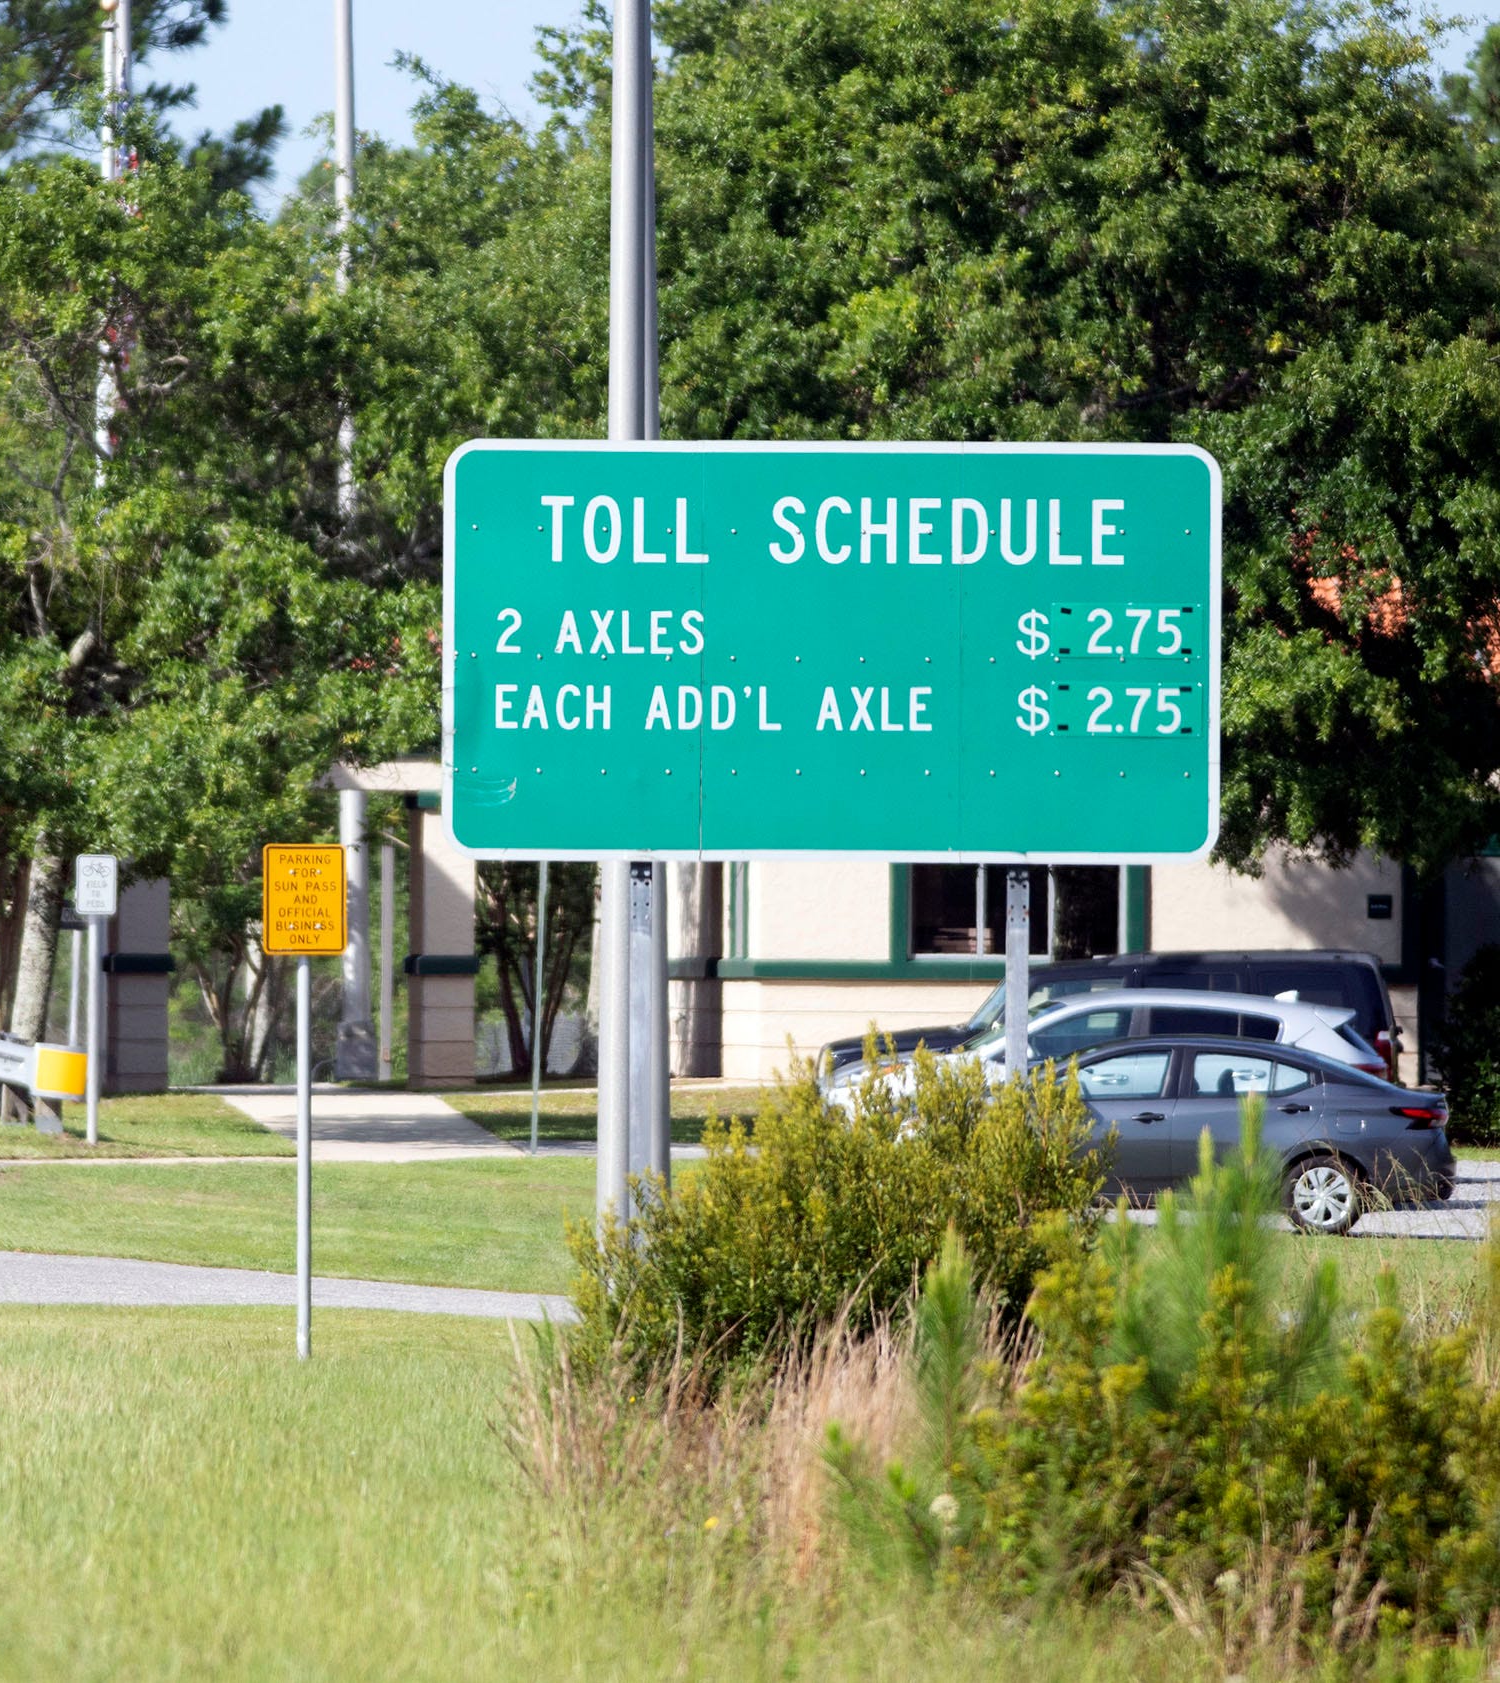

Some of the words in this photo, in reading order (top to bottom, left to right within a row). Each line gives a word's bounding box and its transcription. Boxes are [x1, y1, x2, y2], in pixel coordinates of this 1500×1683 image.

[541, 494, 709, 563] TOLL
[768, 496, 1125, 565] SCHEDULE
[496, 608, 522, 653] 2
[555, 609, 705, 655] AXLES
[1016, 609, 1050, 660] $
[1086, 607, 1183, 655] 2.75
[495, 684, 612, 730] EACH
[644, 685, 782, 731] ADD'L
[816, 686, 932, 731] AXLE
[1016, 684, 1050, 736] $
[1086, 686, 1182, 734] 2.75
[279, 854, 332, 865] PARKING
[293, 867, 318, 878] FOR
[274, 881, 298, 892] SUN
[306, 881, 337, 892] PASS
[294, 894, 318, 905] AND
[278, 907, 331, 918] OFFICIAL
[275, 920, 335, 931] BUSINESS
[289, 934, 321, 945] ONLY
